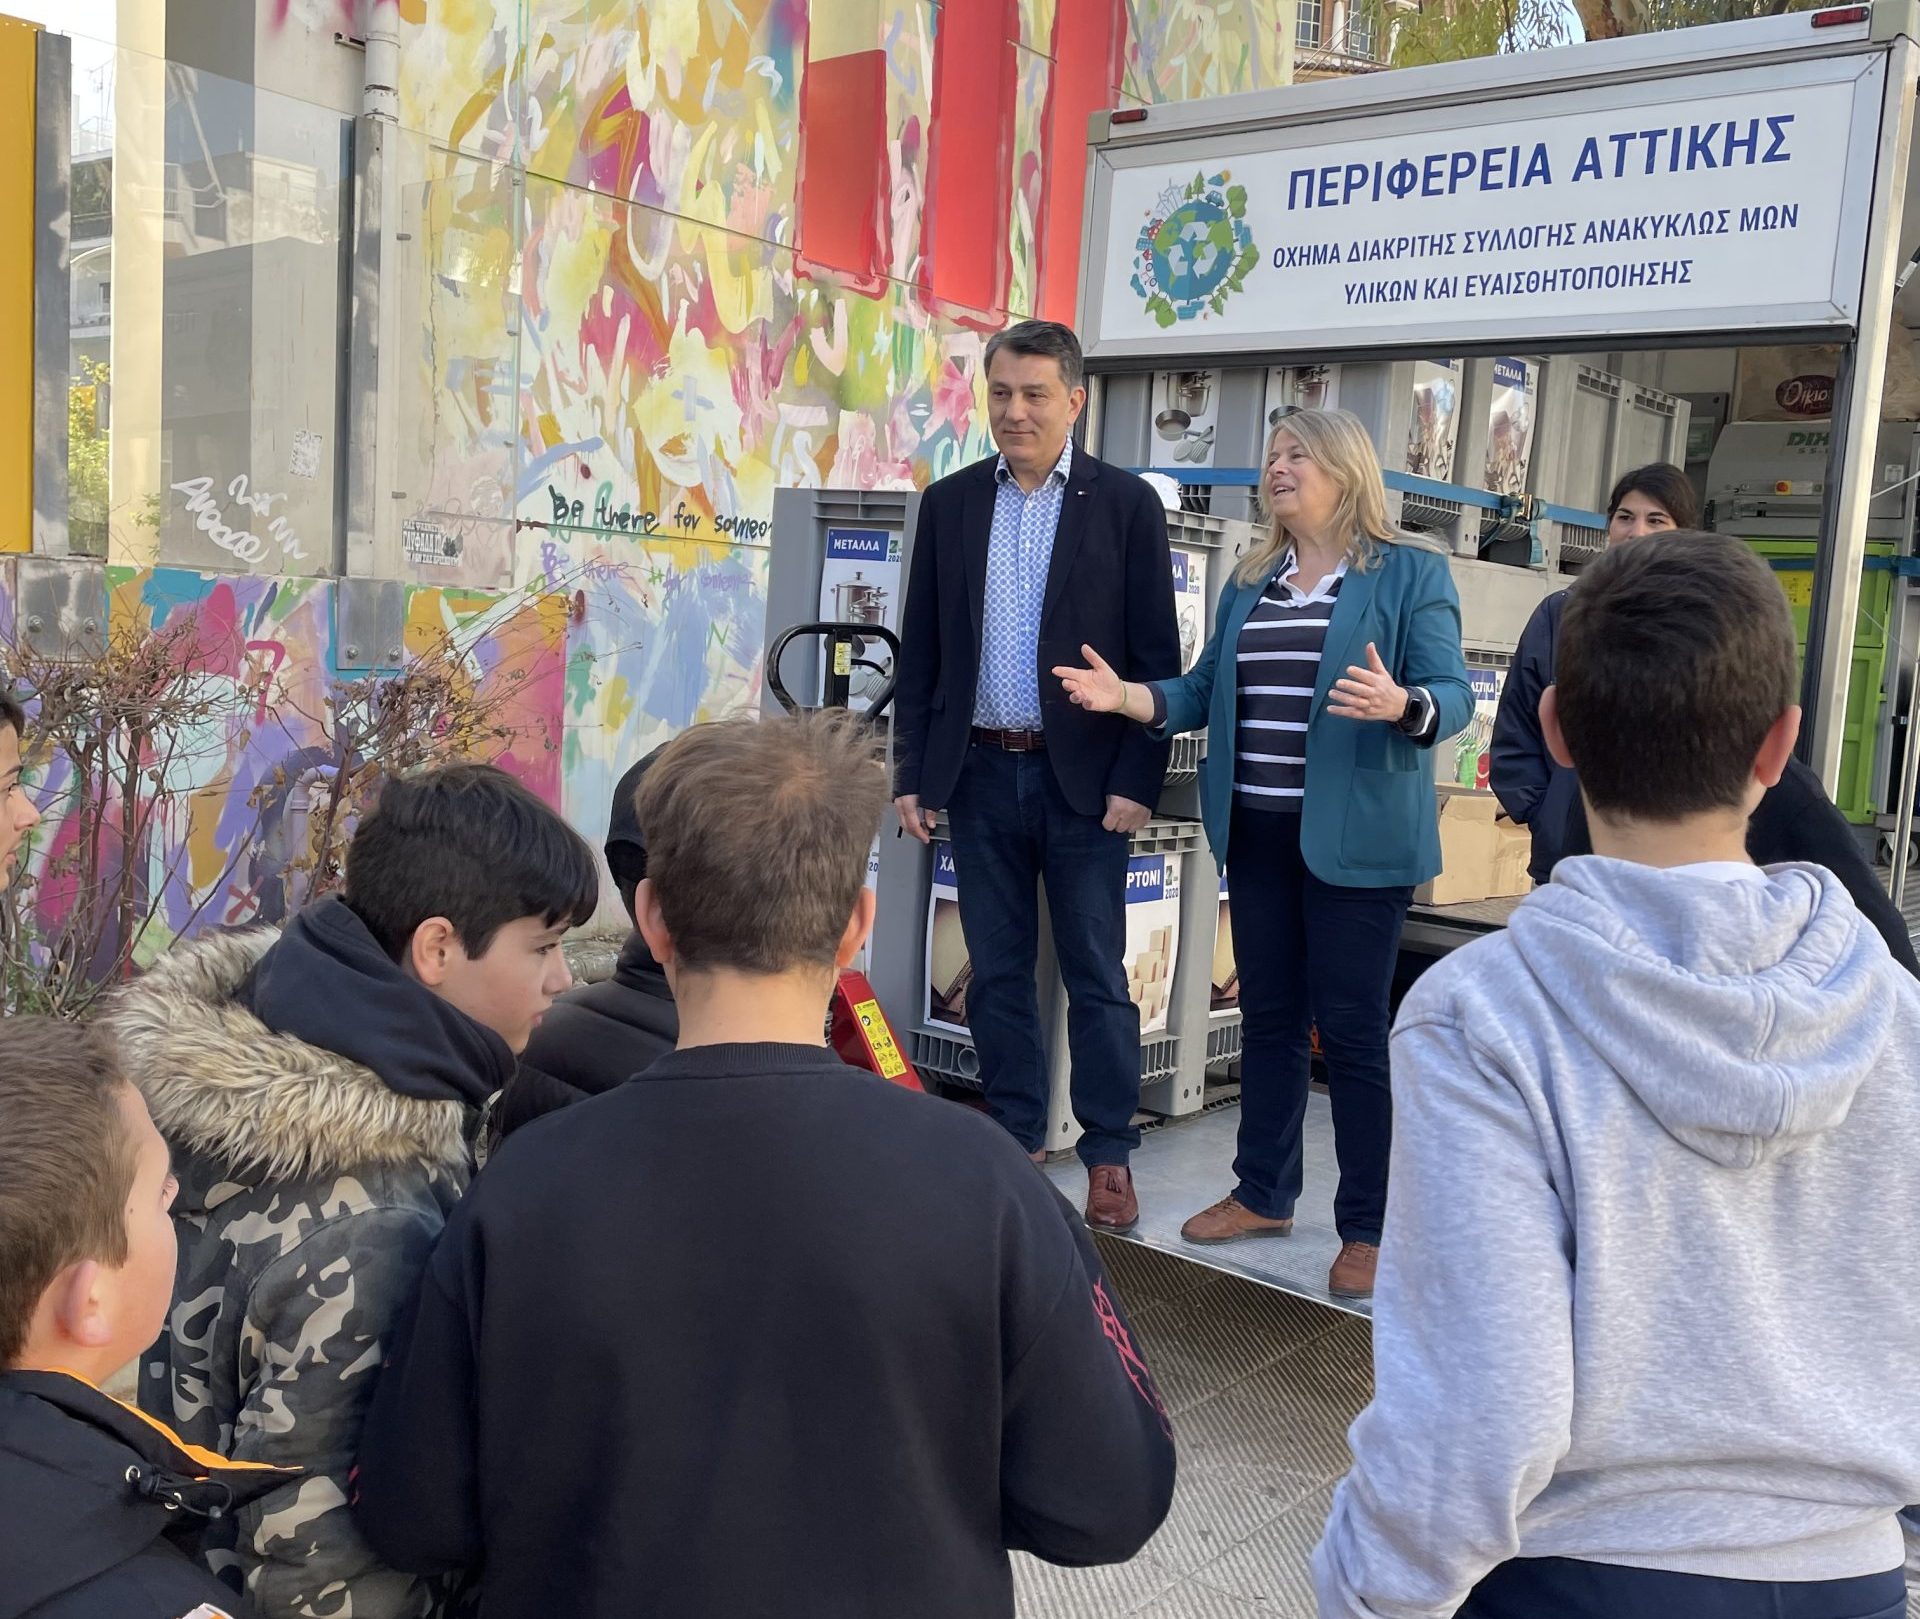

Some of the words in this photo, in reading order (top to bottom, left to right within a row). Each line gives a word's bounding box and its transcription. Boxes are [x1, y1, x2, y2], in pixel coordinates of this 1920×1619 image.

[1287, 142, 1553, 211] ΠΕΡΙΦΕΡΕΙΑ
[1571, 114, 1794, 183] ΑΤΤΙΚΗΣ
[1272, 240, 1341, 269] ΟΧΗΜΑ
[1346, 233, 1456, 263] ΔΙΑΚΡΙΤΗΣ
[1463, 223, 1577, 254] ΣΥΛΛΟΓΗΣ
[1583, 209, 1730, 244] ΑΝΑΚΥΚΛΩΣ
[1738, 204, 1799, 232] ΜΩΝ
[1344, 279, 1418, 305] ΥΛΙΚΩΝ
[1423, 277, 1459, 301] ΚΑΙ
[1465, 259, 1694, 298] ΕΥΑΙΣΘΗΤΟΠΟΙΗΣΗΣ
[596, 497, 660, 534] there
[714, 513, 773, 539] someo
[833, 538, 880, 552] ΜΕΤΑΛΛΑ
[1126, 869, 1161, 889] ΡΤΟΝΙ
[1165, 887, 1179, 899] 2020
